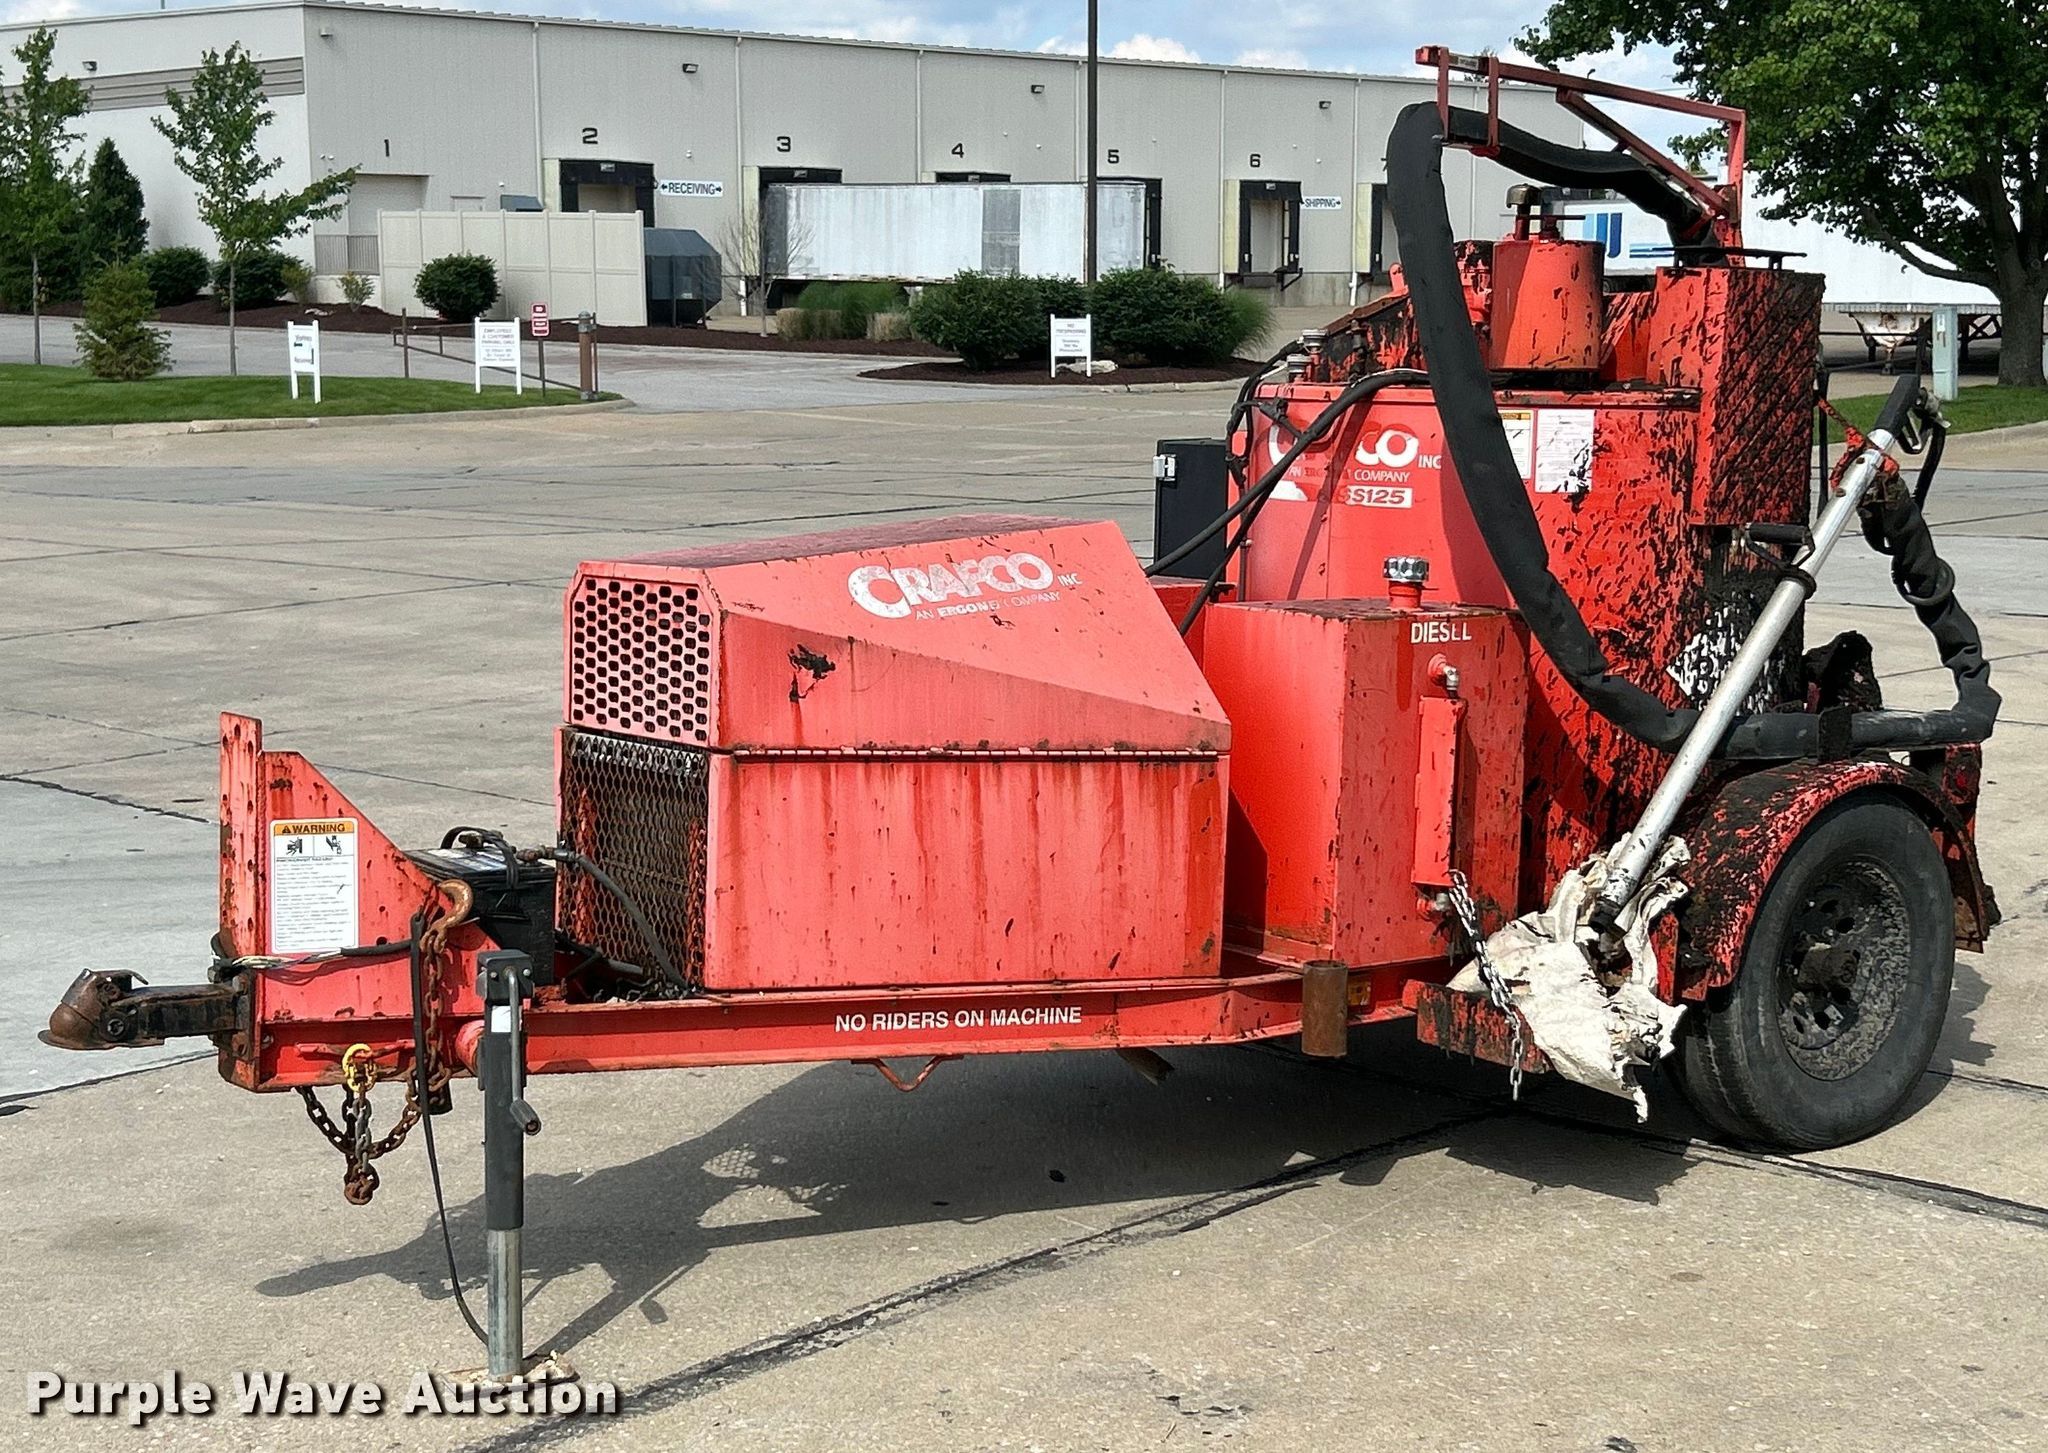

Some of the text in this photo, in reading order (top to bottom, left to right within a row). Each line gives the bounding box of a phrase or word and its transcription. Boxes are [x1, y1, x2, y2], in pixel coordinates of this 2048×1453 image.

[583, 128, 598, 144] 2
[383, 138, 390, 157] 1
[777, 136, 792, 153] 3
[951, 143, 965, 158] 4
[1107, 149, 1119, 164] 5
[1250, 153, 1261, 167] 6
[668, 182, 716, 195] RECEIVING
[1305, 198, 1336, 208] SHIPPING
[1418, 454, 1442, 470] INC
[1354, 469, 1410, 482] COMPANY
[847, 552, 1083, 618] CRAFCO INC
[915, 610, 934, 621] AN
[292, 823, 346, 833] WARNING
[835, 1006, 1082, 1032] NO RIDERS ON MACHINE
